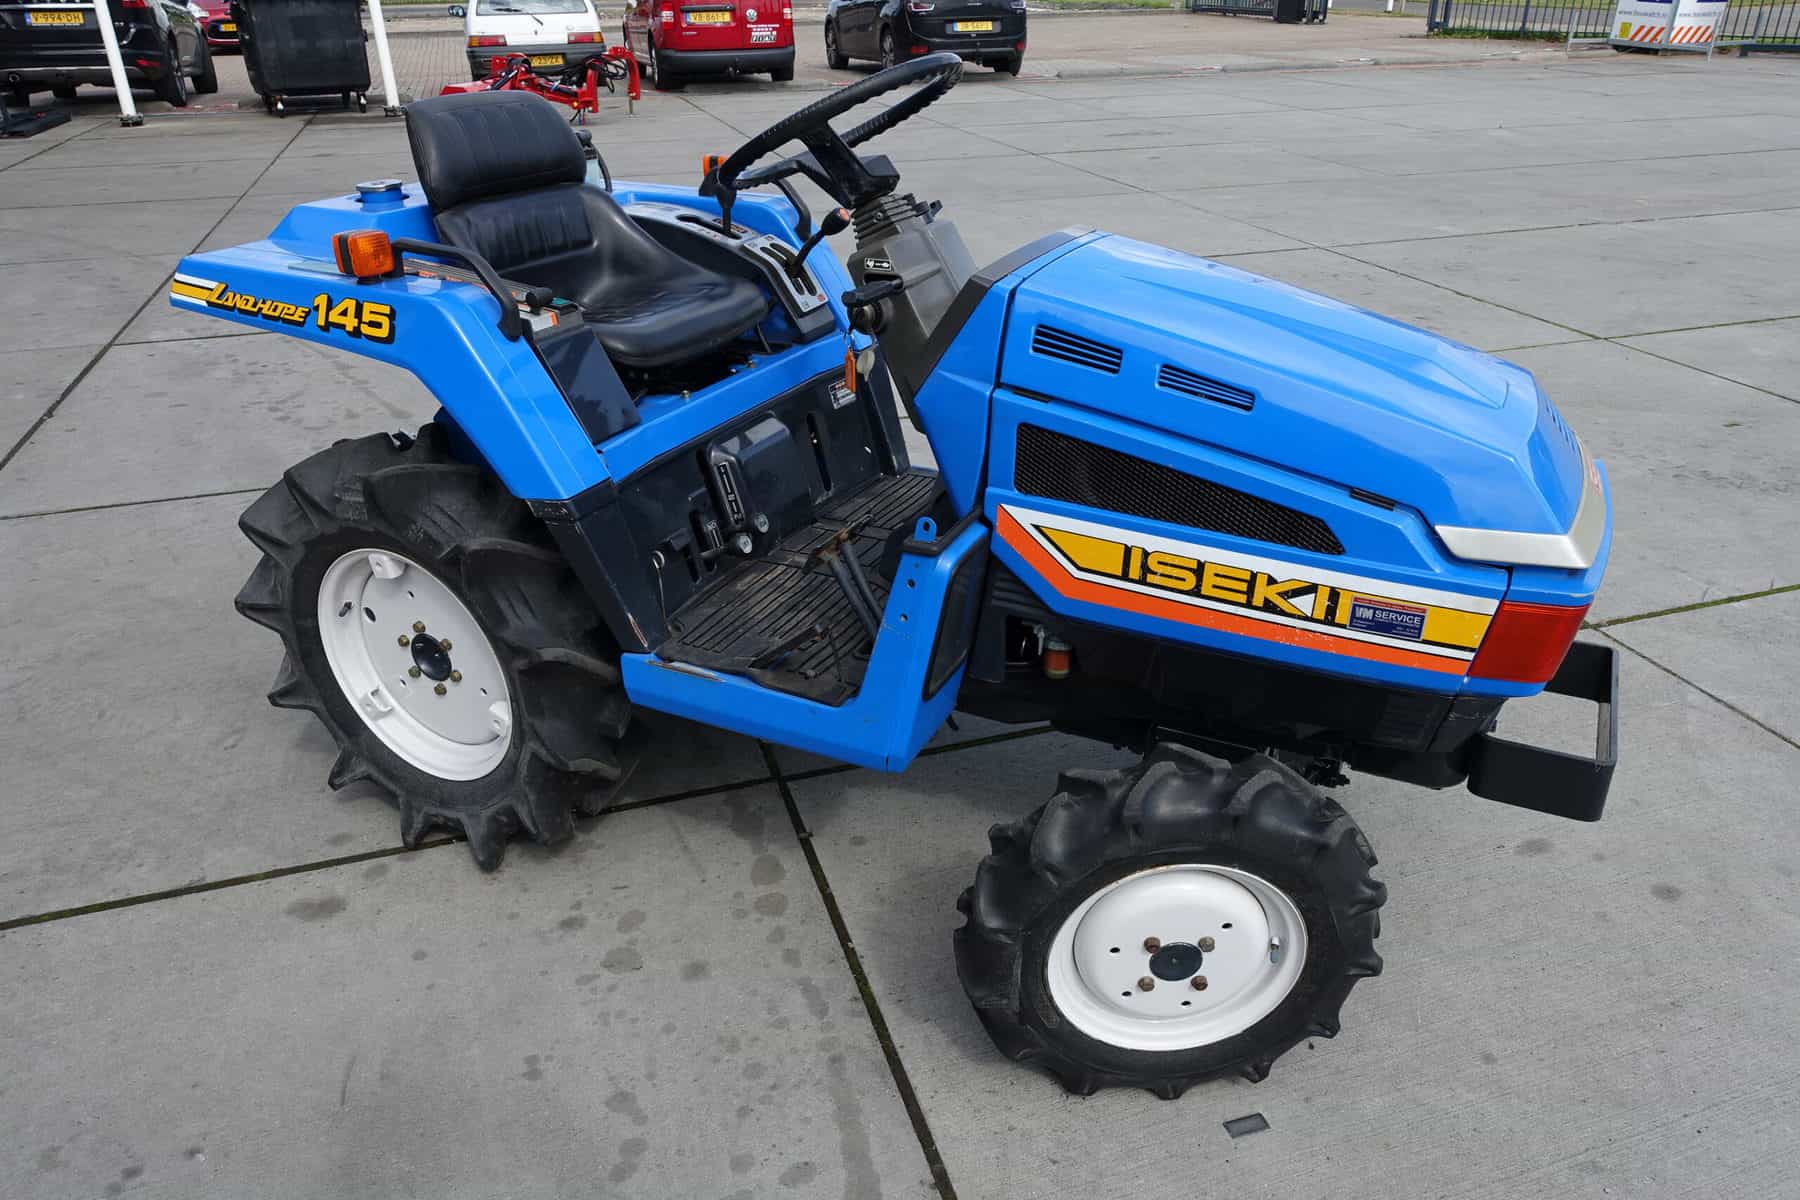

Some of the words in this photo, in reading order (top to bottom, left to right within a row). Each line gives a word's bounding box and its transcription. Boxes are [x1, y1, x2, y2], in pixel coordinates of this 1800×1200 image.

[313, 293, 393, 341] 145
[1129, 546, 1332, 620] ISEKI
[1375, 610, 1422, 625] SERVICE
